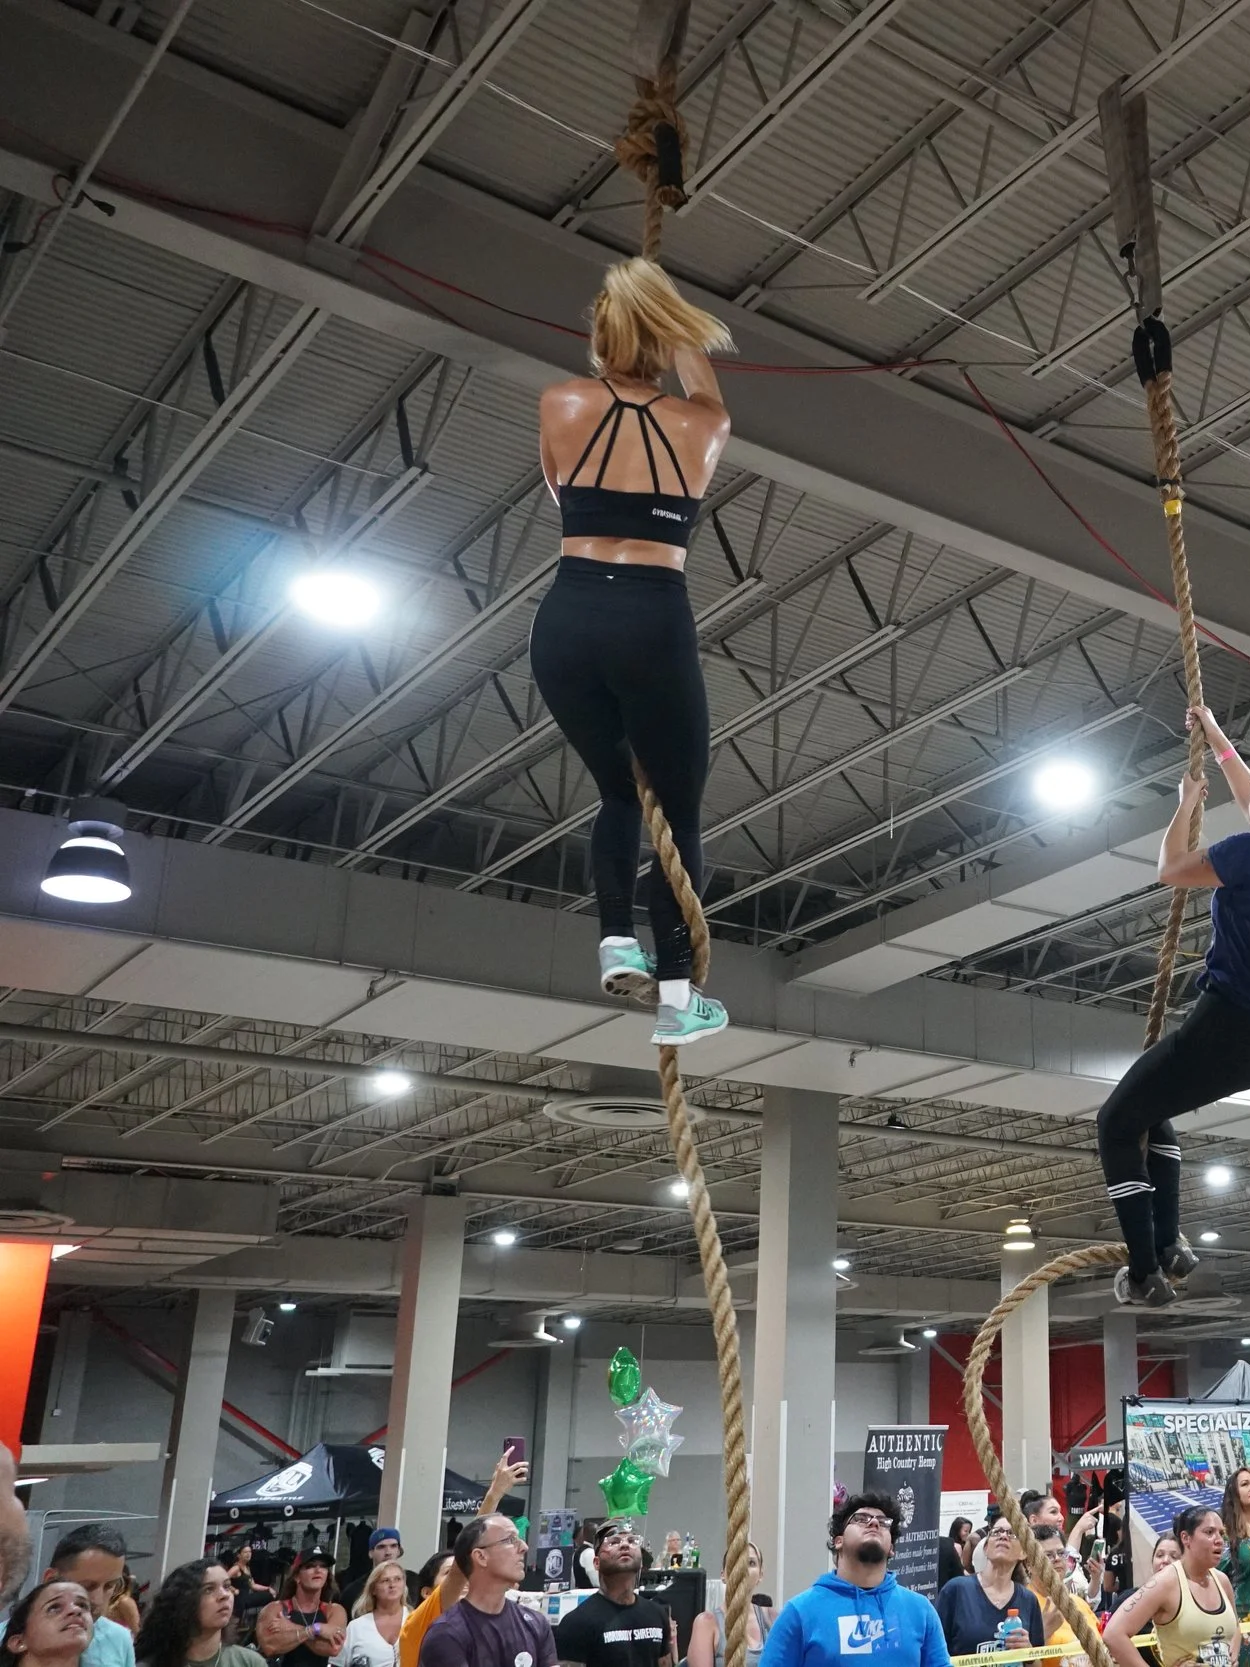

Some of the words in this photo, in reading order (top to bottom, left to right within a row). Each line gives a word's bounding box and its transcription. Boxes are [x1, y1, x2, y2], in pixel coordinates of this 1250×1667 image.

[867, 1433, 943, 1453] AUTHENTIC
[876, 1456, 892, 1473] High
[893, 1456, 918, 1472] Country
[918, 1455, 937, 1470] Hemp
